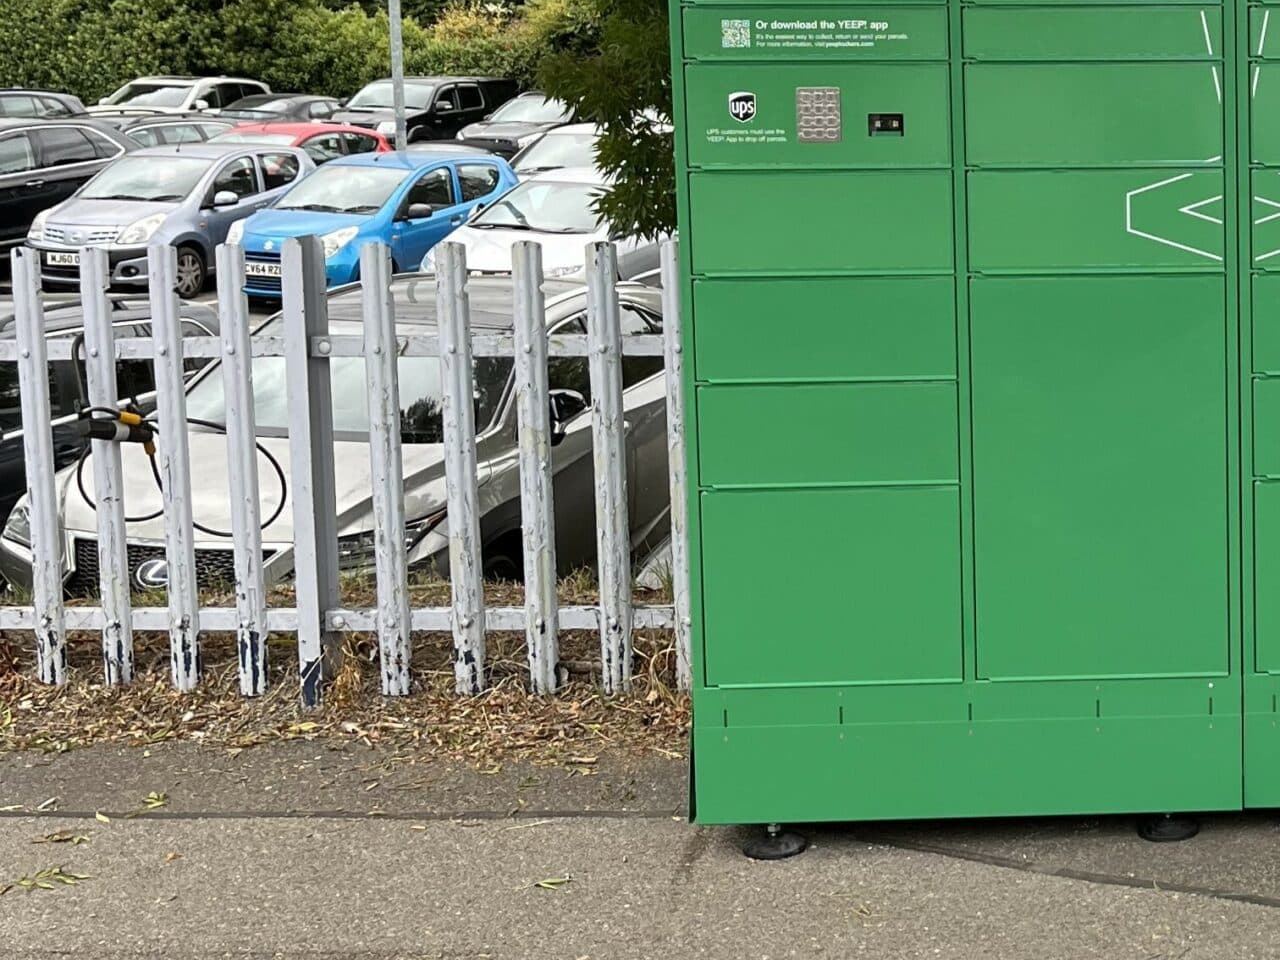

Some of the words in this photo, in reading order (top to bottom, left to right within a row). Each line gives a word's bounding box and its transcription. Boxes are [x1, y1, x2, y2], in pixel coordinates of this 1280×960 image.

[756, 21, 767, 29] Or
[771, 20, 817, 29] download
[820, 20, 835, 29] the
[838, 20, 867, 29] YEEP!
[870, 21, 888, 31] app
[731, 101, 754, 118] ups
[51, 255, 72, 263] MJ60
[245, 264, 266, 273] CV64
[268, 266, 281, 274] RZ
